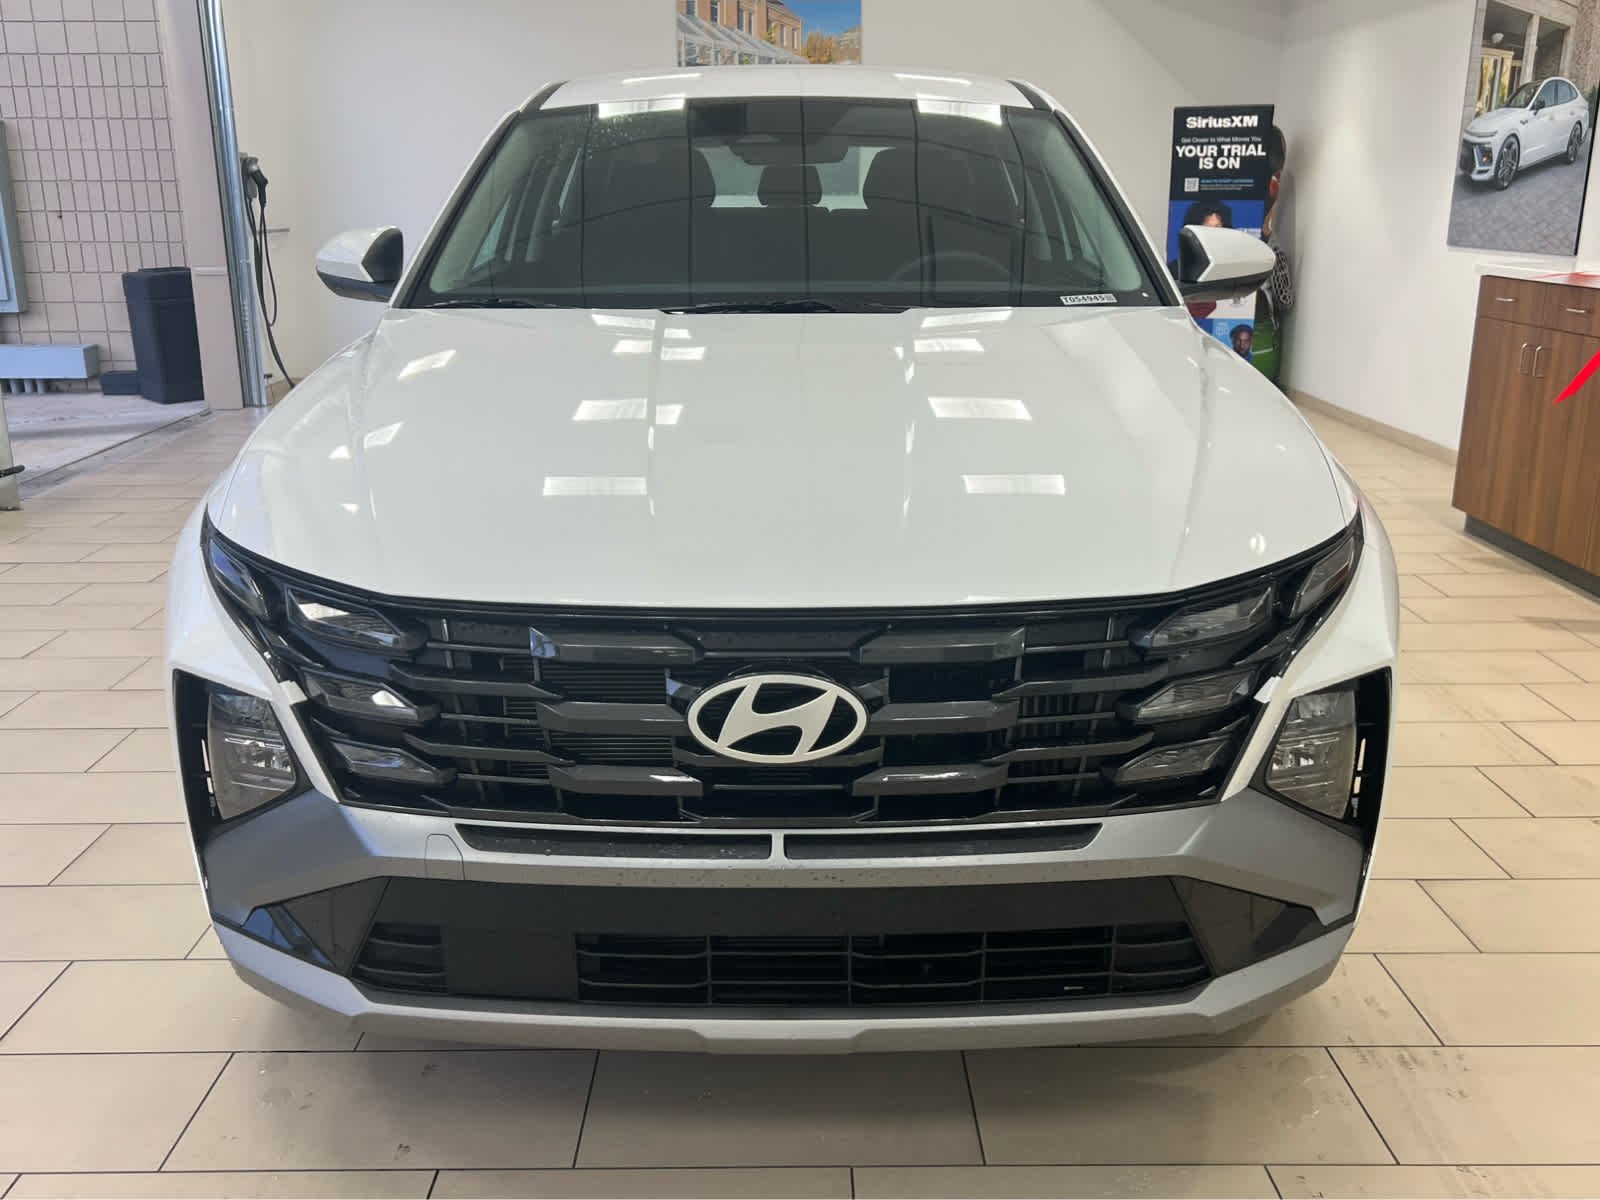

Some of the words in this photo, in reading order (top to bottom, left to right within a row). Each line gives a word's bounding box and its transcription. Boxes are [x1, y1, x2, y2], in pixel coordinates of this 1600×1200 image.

[1186, 115, 1258, 128] SiriusXM
[1176, 145, 1218, 157] YOUR
[1221, 144, 1266, 156] TRIAL
[1199, 157, 1214, 169] IS
[1216, 157, 1240, 169] ON
